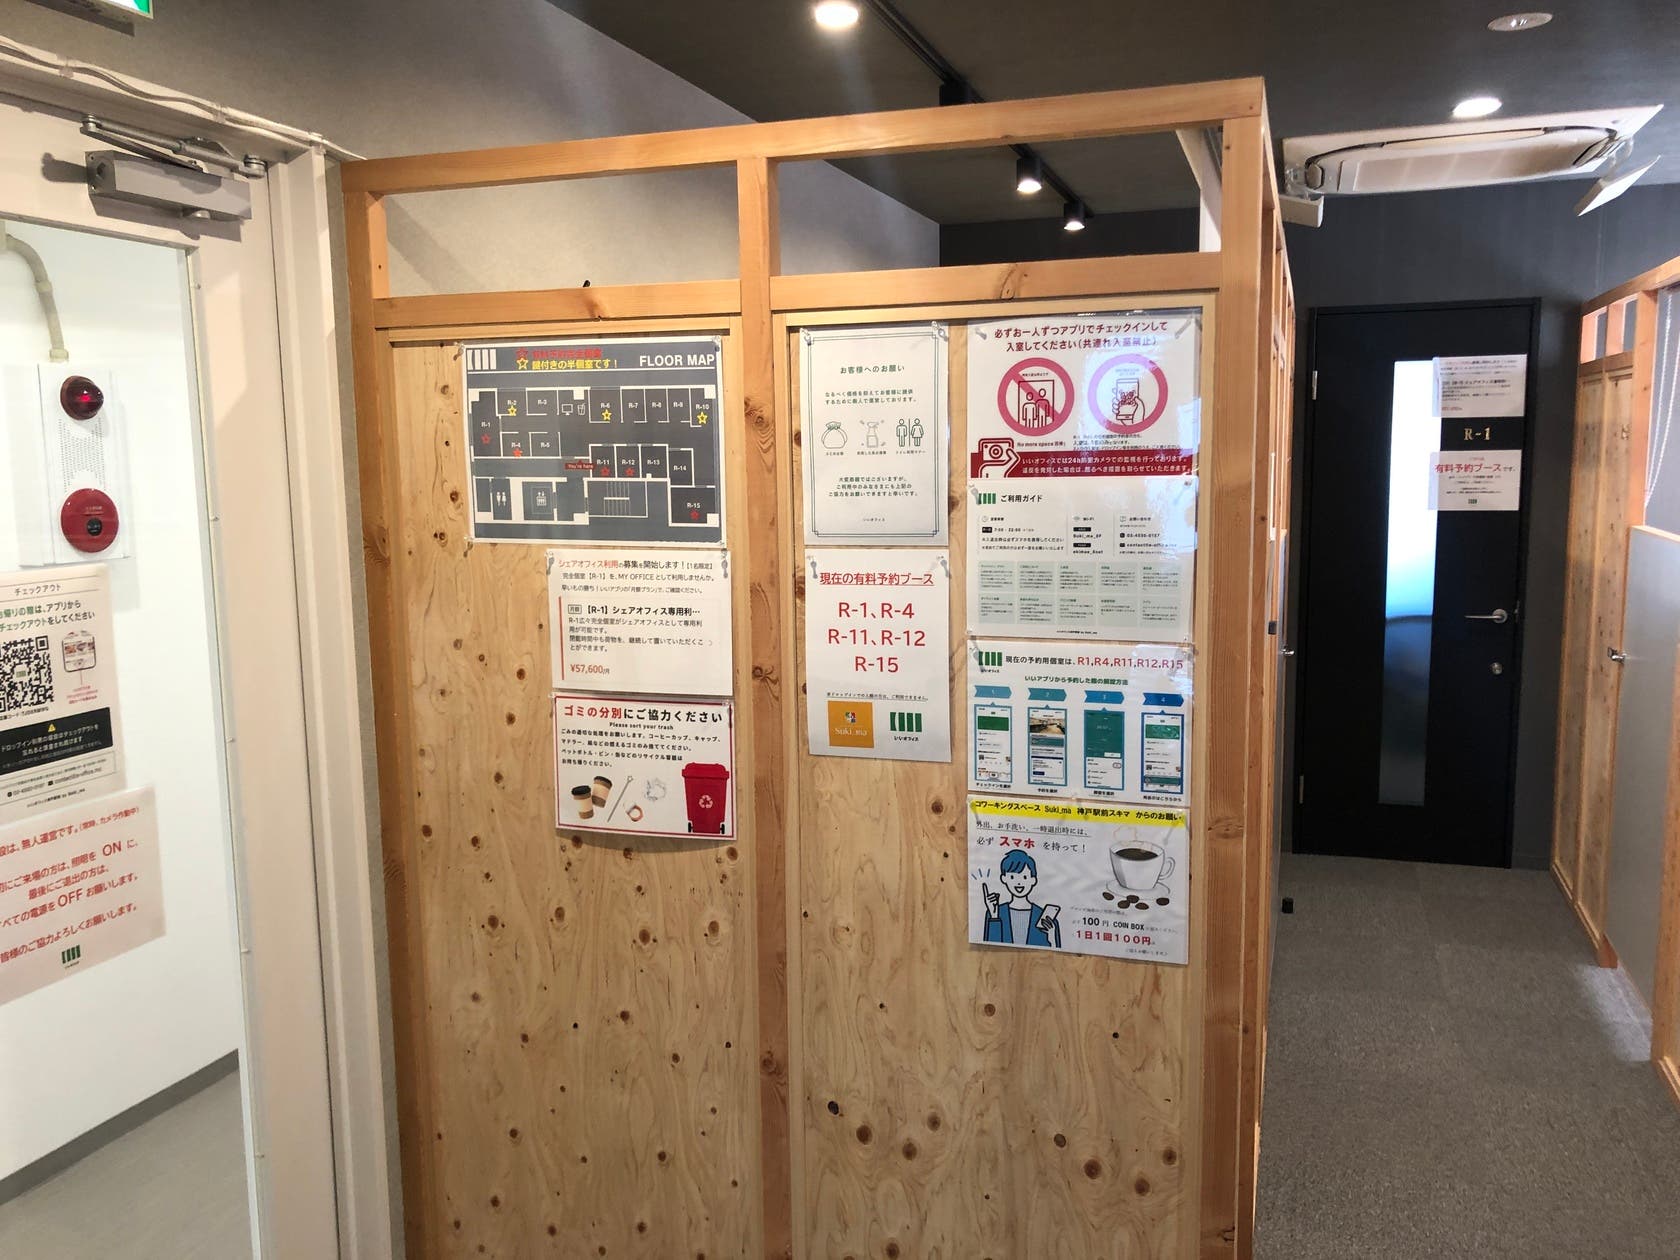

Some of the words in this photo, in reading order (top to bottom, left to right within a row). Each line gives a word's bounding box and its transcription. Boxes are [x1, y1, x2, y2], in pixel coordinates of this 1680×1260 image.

[994, 321, 1168, 339] 必ずお一人ずつアプリでチェックインして
[639, 354, 683, 367] FLOOR
[686, 353, 715, 366] MAP
[840, 364, 905, 374] お客様へのお願い
[1463, 427, 1491, 441] R-1
[1435, 463, 1501, 473] 有料予約ブース
[1000, 494, 1043, 503] ご利用ガイド
[629, 573, 655, 581] OFFICE
[819, 572, 934, 586] 現在の有料予約ブース
[15, 584, 61, 596] チェックアウト
[838, 602, 915, 619] R-1、R-4
[0, 611, 95, 632] チェックアウトをしてください
[569, 626, 608, 634] 用が可能です。
[827, 628, 926, 647] R-11、R-12
[854, 656, 899, 673] R-15
[564, 705, 723, 723] ゴミの分別にご協力ください
[562, 759, 613, 767] お持ち帰りください。
[975, 800, 1041, 811] コワーキングスペース
[1077, 807, 1130, 817] 神戸駅前スキマ
[1135, 811, 1182, 821] からのお願い
[102, 841, 122, 857] ON
[977, 836, 994, 846] 必ず
[999, 836, 1035, 849] スマホ
[1043, 841, 1086, 853] を持って！
[28, 865, 109, 900] 最後にご退出の方は、
[0, 902, 56, 928] べての電源を
[57, 887, 84, 907] OFF
[86, 872, 138, 897] お願いします。
[1082, 917, 1100, 926] 100
[1112, 921, 1129, 929] COIN
[1130, 923, 1145, 931] BOX
[0, 903, 137, 964] 皆様のご協力よろしくお願いします。
